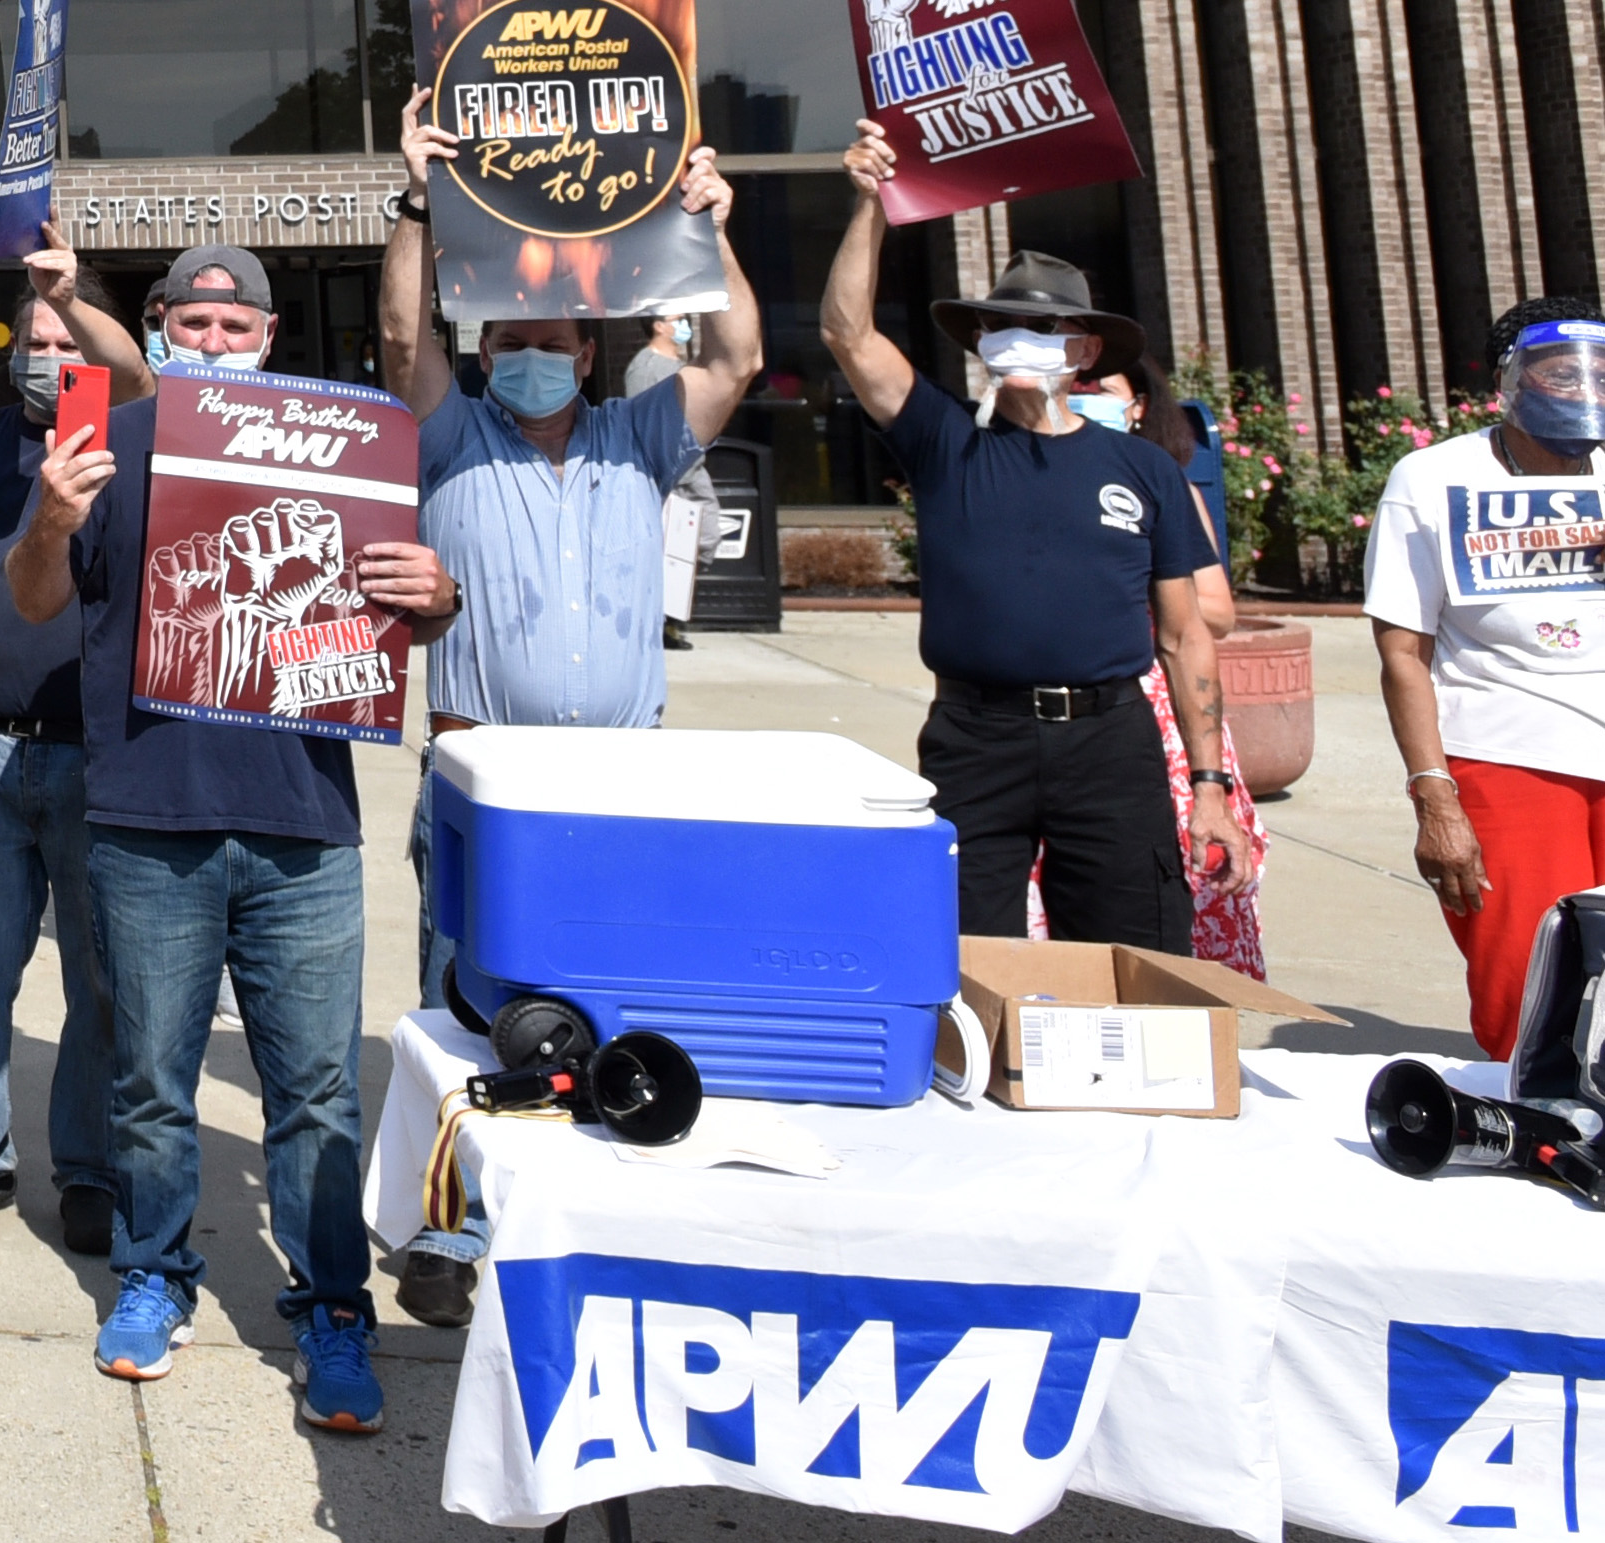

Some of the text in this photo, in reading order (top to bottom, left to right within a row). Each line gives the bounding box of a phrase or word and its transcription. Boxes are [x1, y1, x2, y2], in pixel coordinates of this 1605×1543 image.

[499, 8, 607, 42] APWU
[482, 38, 630, 59] American Postal
[493, 57, 620, 74] Workers Union
[867, 11, 1034, 109] FIGHTING
[963, 61, 1010, 101] for
[454, 76, 669, 140] FIRED UP!
[915, 71, 1088, 154] JUSTICE
[2, 129, 42, 166] Better
[474, 123, 604, 181] Ready
[541, 146, 656, 212] to go!
[85, 193, 224, 225] STATES
[253, 193, 358, 221] POST
[196, 387, 379, 444] Happy Birthday
[223, 424, 349, 468] APWU
[1487, 491, 1594, 527] U.S.
[1468, 531, 1512, 554] NOT
[1517, 528, 1561, 549] FOR
[176, 569, 222, 591] 1971
[1491, 551, 1594, 578] MAIL
[319, 586, 366, 609] 2016
[265, 615, 378, 669] FIGHTING
[276, 650, 397, 706] JUSTICE!
[534, 1294, 1116, 1498] APWU
